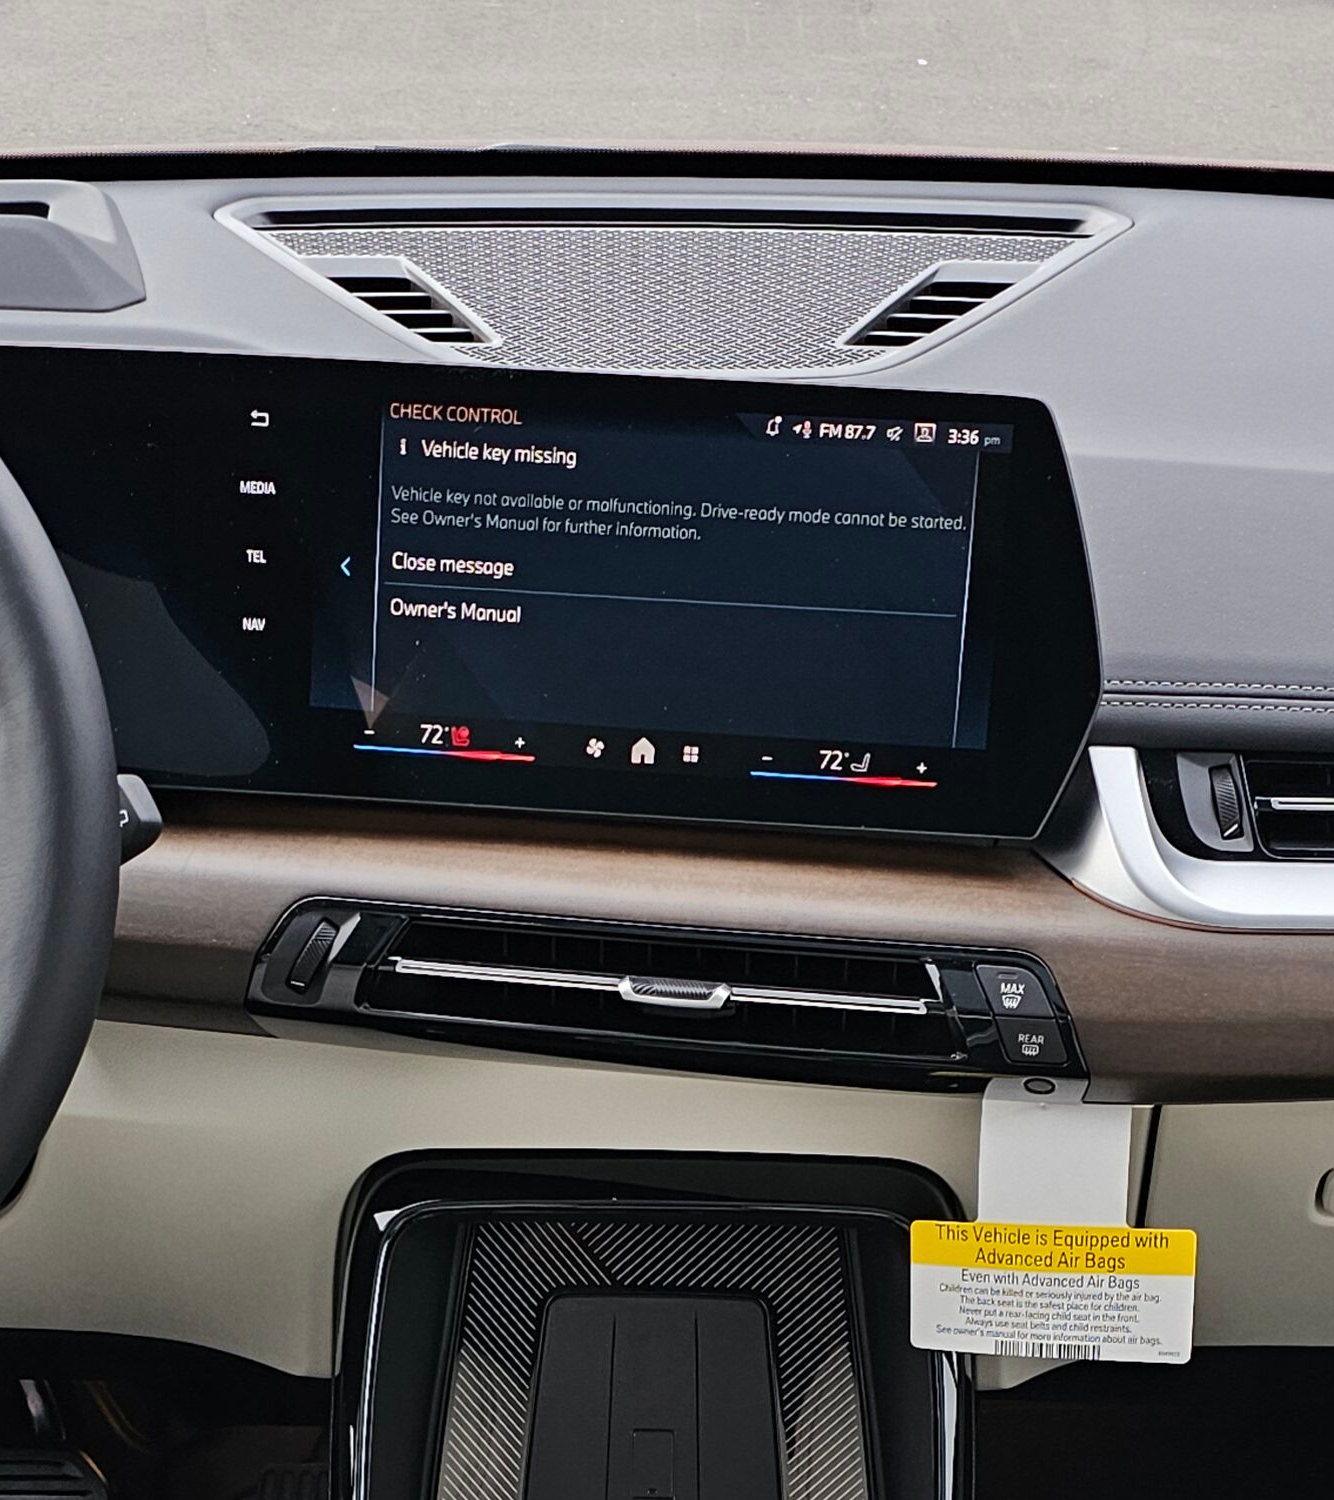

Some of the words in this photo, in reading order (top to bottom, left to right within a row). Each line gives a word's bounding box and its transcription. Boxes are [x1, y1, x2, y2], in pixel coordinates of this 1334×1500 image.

[390, 403, 443, 421] CHECK
[446, 406, 522, 425] CONTROL
[819, 423, 842, 440] FM
[844, 424, 877, 441] 87.7
[947, 428, 980, 446] 3:36
[984, 436, 1001, 447] pm
[422, 439, 478, 460] Vehicle
[482, 442, 511, 465] key
[515, 445, 577, 469] missing
[239, 480, 276, 495] MEDIA
[391, 485, 442, 503] Vehicle
[446, 488, 470, 507] key
[474, 491, 497, 507] not
[501, 493, 564, 511] available
[569, 498, 583, 511] or
[586, 498, 697, 521] malfunctioning.
[700, 502, 786, 524] Drive-ready
[788, 508, 830, 525] mode
[834, 511, 885, 527] cannot
[888, 512, 908, 528] be
[911, 514, 967, 531] started.
[391, 508, 419, 525] See
[422, 510, 482, 529] Owner's
[486, 514, 539, 531] Manual
[542, 516, 562, 532] for
[565, 519, 612, 536] further
[616, 522, 701, 540] information.
[246, 549, 267, 563] TEL
[392, 551, 436, 572] Close
[440, 558, 515, 579] message
[390, 597, 457, 619] Owner's
[461, 602, 522, 623] Manual
[242, 617, 266, 631] NAV
[1000, 982, 1025, 994] MAX
[1018, 1034, 1044, 1045] REAR
[935, 1224, 968, 1241] This
[973, 1226, 1030, 1245] Vehicle
[1036, 1229, 1047, 1246] is
[1053, 1230, 1130, 1250] Equipped
[1135, 1232, 1169, 1248] with
[975, 1247, 1052, 1267] Advanced
[1057, 1252, 1081, 1268] Air
[1085, 1252, 1126, 1273] Bags
[961, 1268, 990, 1283] Even
[993, 1272, 1019, 1286] with
[1022, 1273, 1084, 1288] Advanced
[1087, 1275, 1105, 1288] Air
[1108, 1275, 1140, 1292] Bags
[939, 1283, 972, 1293] Children
[974, 1287, 987, 1296] can
[990, 1286, 1001, 1296] be
[1002, 1286, 1023, 1297] killed
[1025, 1290, 1034, 1298] or
[1036, 1290, 1072, 1301] seriously
[1074, 1292, 1103, 1302] injured
[1105, 1292, 1113, 1303] by
[1116, 1293, 1129, 1302] the
[1131, 1294, 1141, 1302] air
[1144, 1294, 1161, 1304] bag.
[960, 1295, 975, 1304] The
[977, 1296, 995, 1305] back
[997, 1298, 1014, 1306] seat
[1016, 1299, 1023, 1308] is
[1024, 1300, 1038, 1308] the
[1039, 1300, 1065, 1310] safest
[1067, 1302, 1088, 1312] place
[1091, 1302, 1102, 1311] for
[1103, 1302, 1139, 1312] children.
[959, 1306, 981, 1315] Never
[984, 1308, 997, 1317] put
[1005, 1310, 1049, 1321] rear-facing
[1051, 1312, 1071, 1321] child
[1073, 1314, 1091, 1322] seat
[1093, 1314, 1100, 1322] in
[1102, 1314, 1116, 1322] the
[1117, 1314, 1139, 1323] front.
[936, 1324, 951, 1333] See
[953, 1327, 984, 1336] owner's
[987, 1330, 1015, 1338] manual
[1017, 1330, 1027, 1339] for
[1053, 1333, 1101, 1342] information
[1103, 1334, 1126, 1344] about
[1128, 1336, 1138, 1344] air
[1140, 1336, 1163, 1346] bags.
[965, 1317, 993, 1328] Always
[995, 1320, 1009, 1328] use
[1011, 1320, 1027, 1328] seat
[1030, 1322, 1049, 1330] belts
[1051, 1323, 1067, 1331] and
[1069, 1323, 1089, 1332] child
[1091, 1324, 1131, 1334] restraints.
